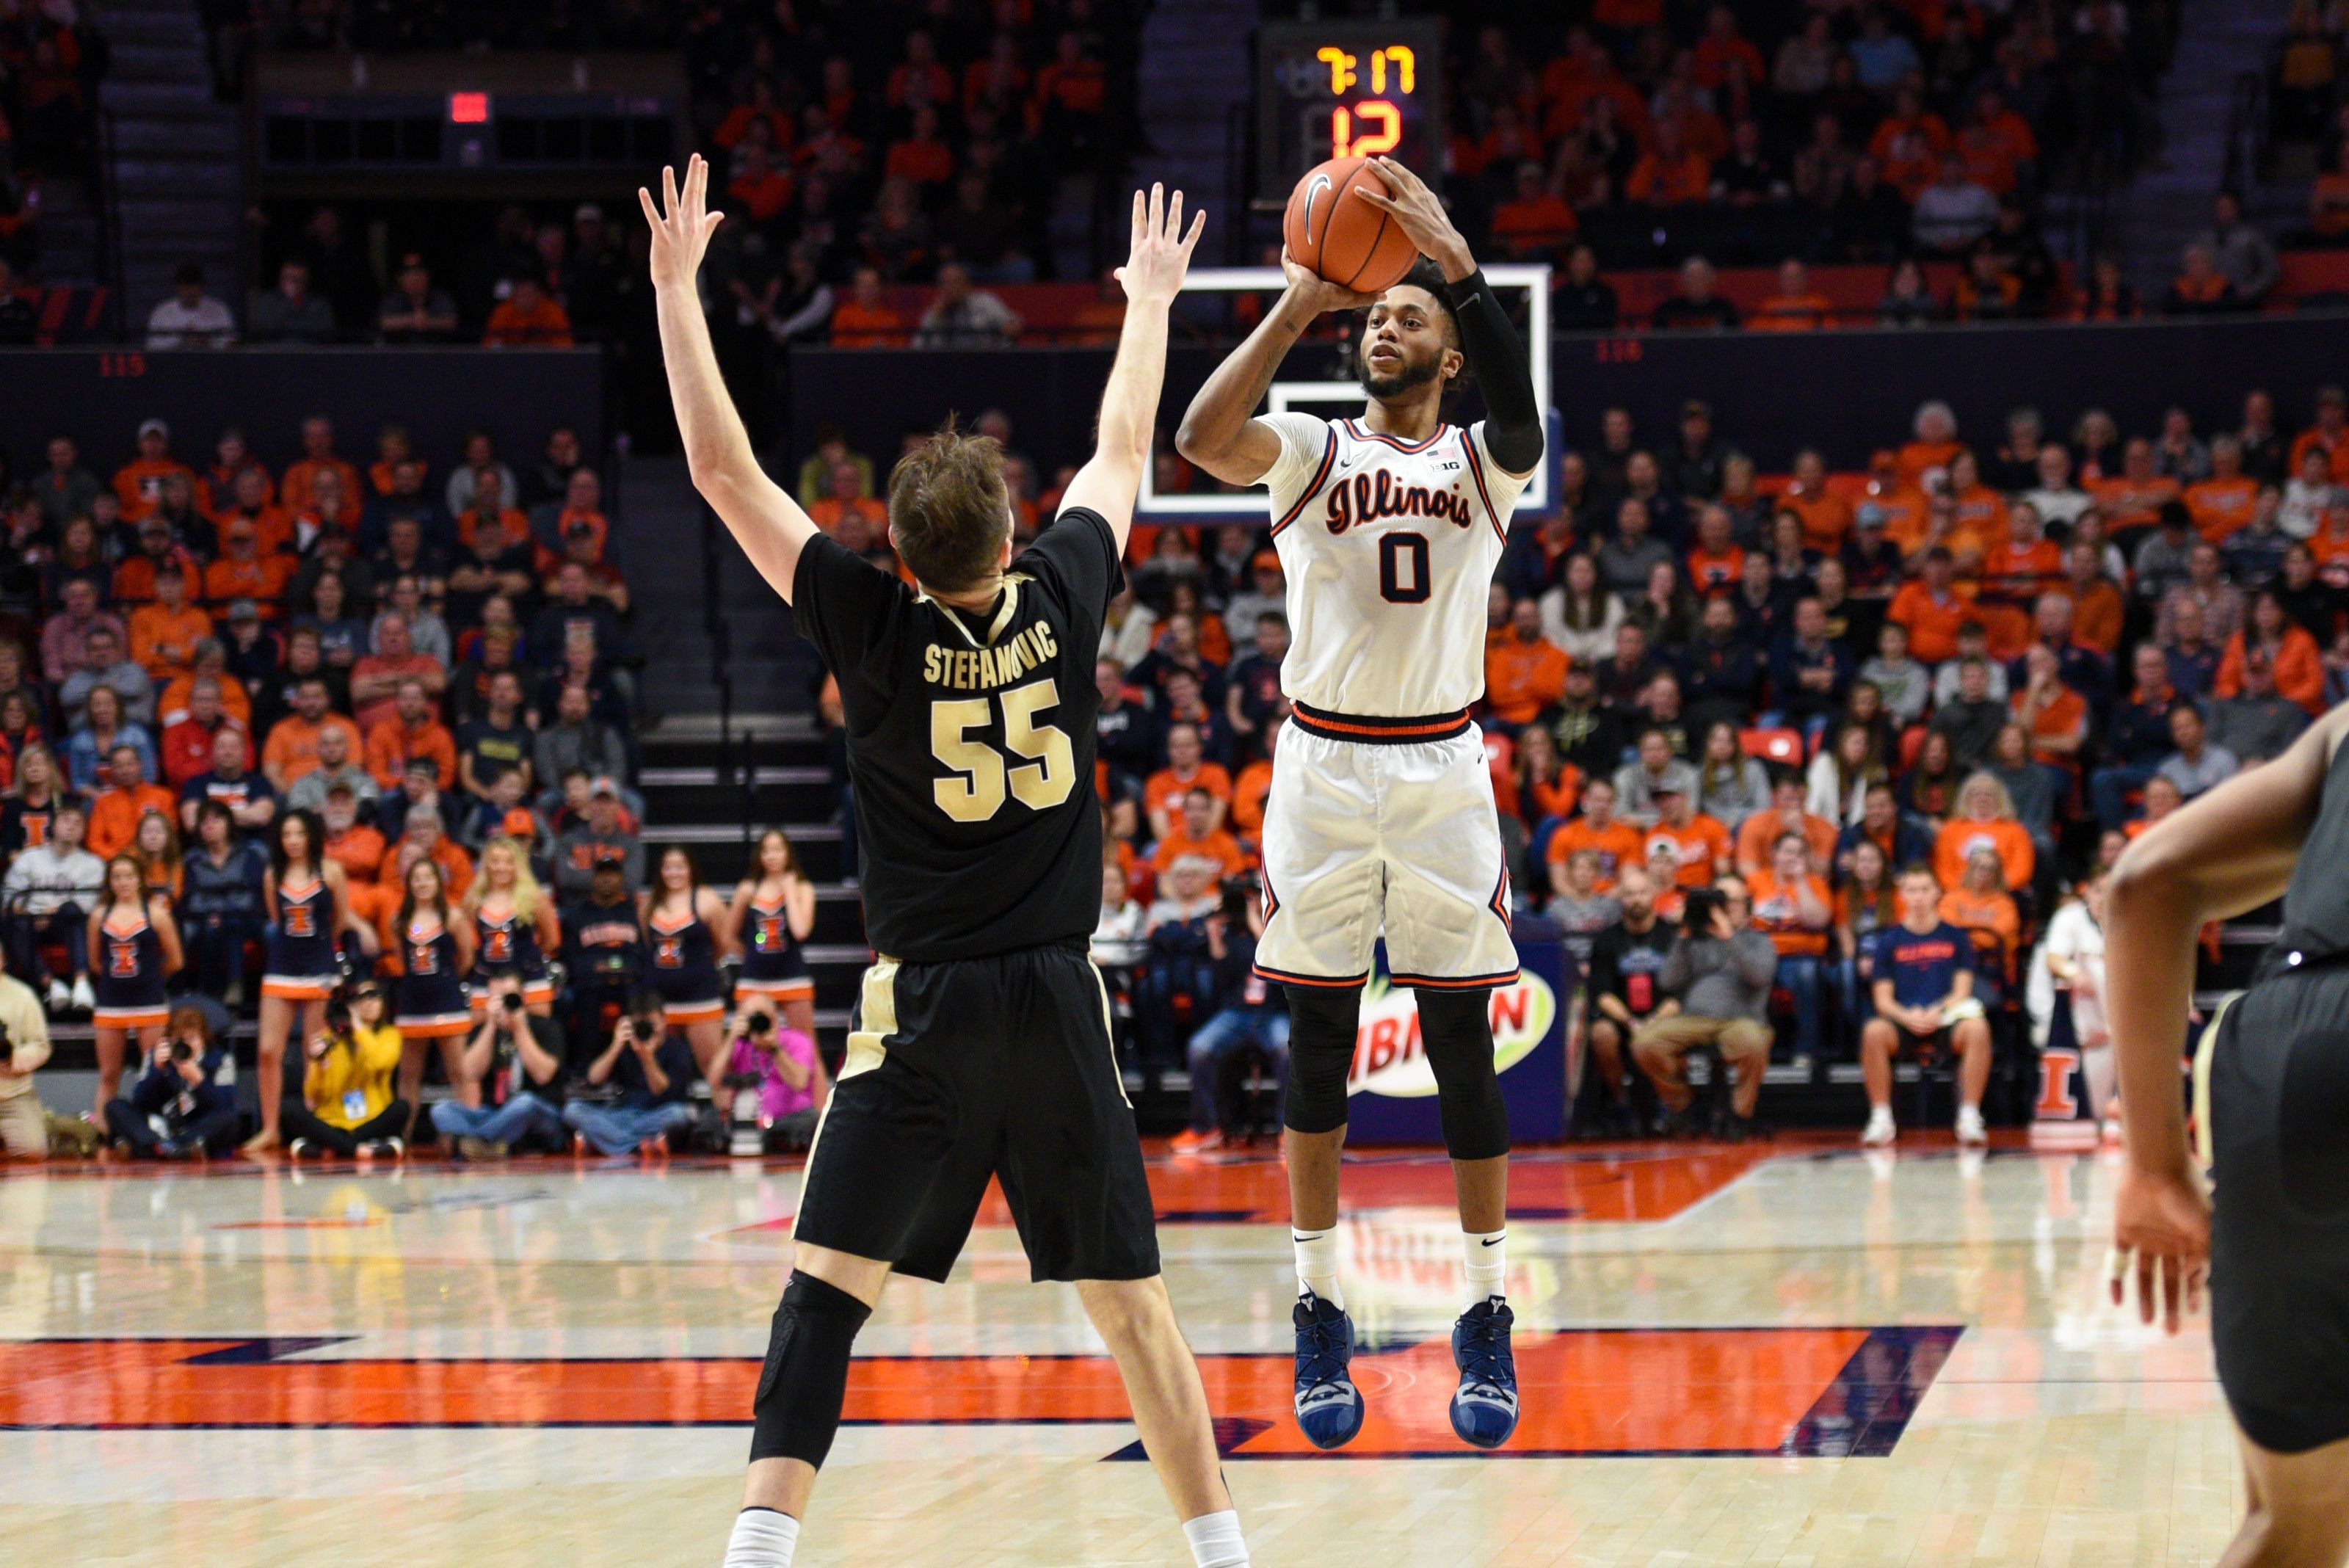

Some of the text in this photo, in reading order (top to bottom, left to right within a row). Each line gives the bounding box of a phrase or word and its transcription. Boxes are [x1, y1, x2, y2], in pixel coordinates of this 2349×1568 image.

[1317, 46, 1415, 95] 7:17
[1332, 100, 1401, 159] 12
[1326, 468, 1471, 535] Illinois
[1379, 531, 1431, 603] 0
[923, 620, 1058, 689] STEFANOVIC
[931, 678, 1076, 822] 55
